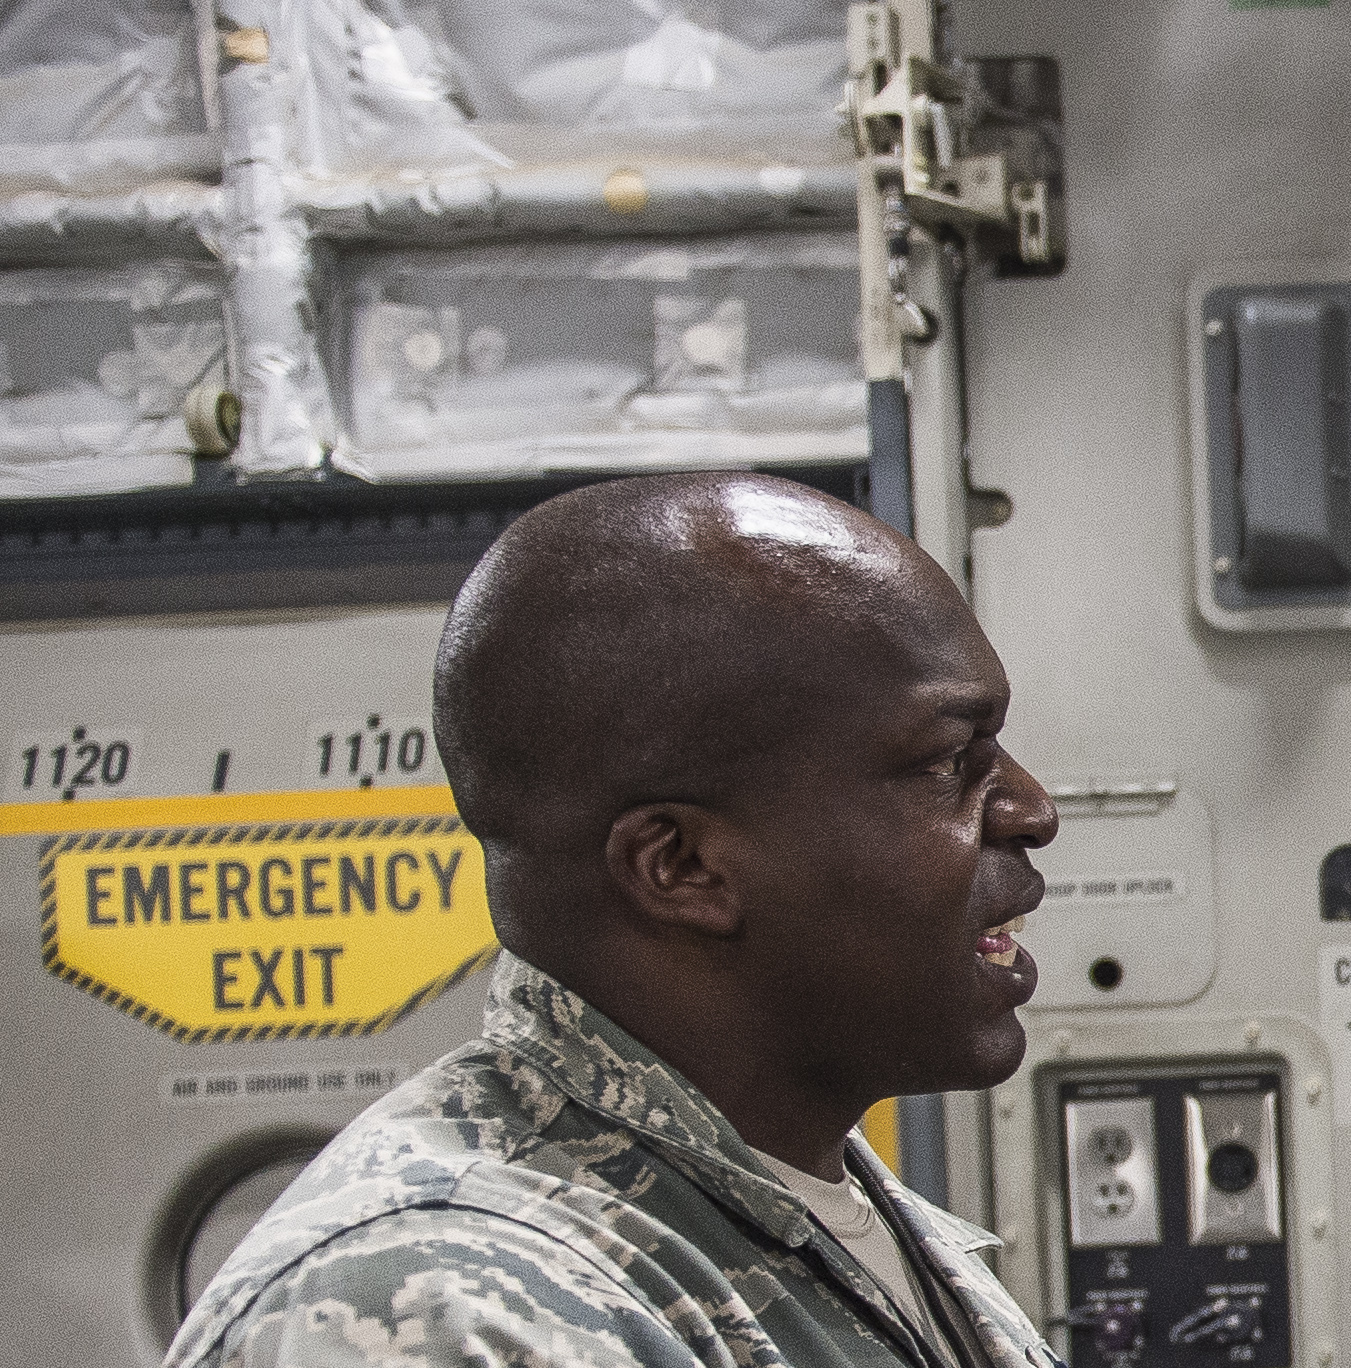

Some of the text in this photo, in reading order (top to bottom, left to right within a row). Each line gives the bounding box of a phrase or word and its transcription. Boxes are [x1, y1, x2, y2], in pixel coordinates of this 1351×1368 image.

[22, 727, 426, 789] 1120 1110
[85, 849, 463, 927] EMERGENCY
[213, 945, 345, 1013] EXIT
[171, 1077, 197, 1097] AIR
[205, 1076, 237, 1096] AND
[245, 1073, 309, 1095] GROUND
